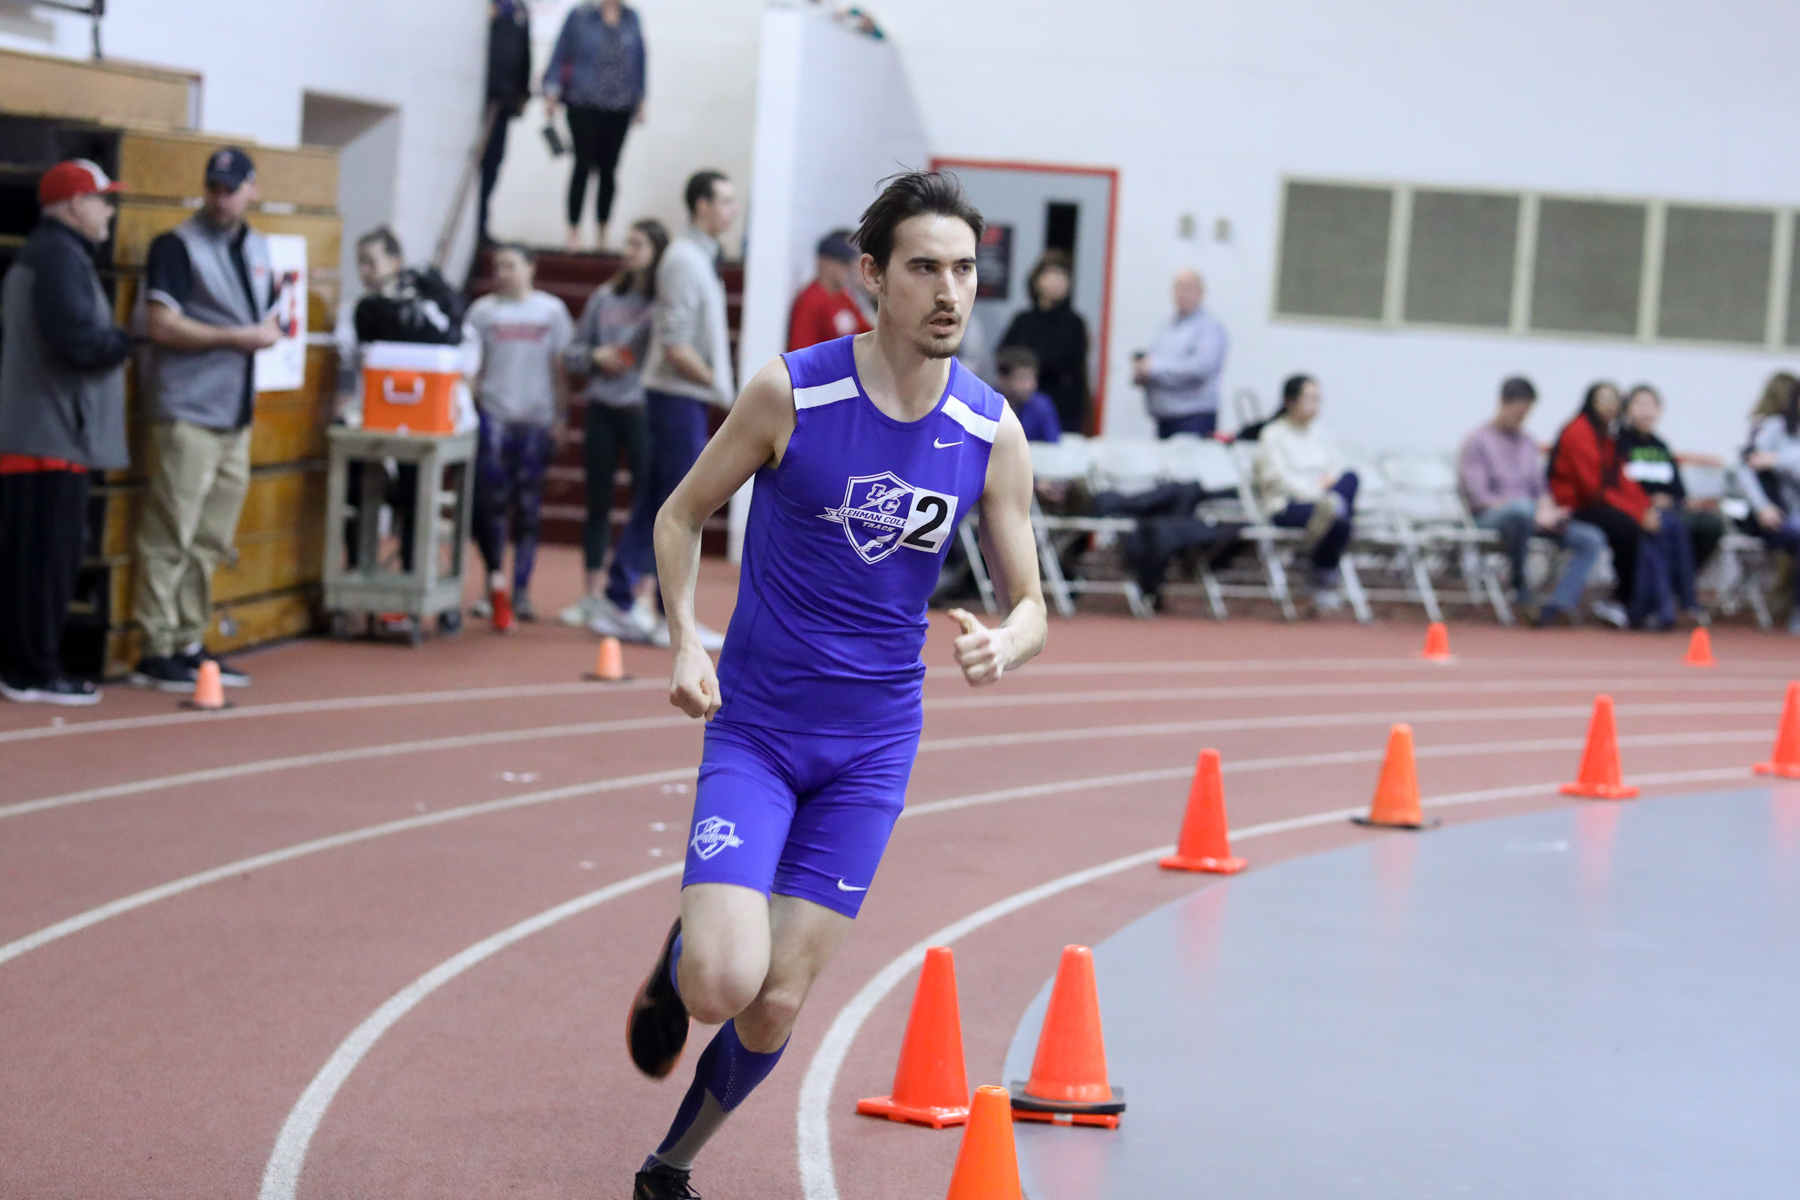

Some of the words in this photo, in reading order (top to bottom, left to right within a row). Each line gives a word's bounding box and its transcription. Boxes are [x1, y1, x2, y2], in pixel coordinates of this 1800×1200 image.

[841, 508, 883, 522] LEHMAN
[902, 495, 949, 549] 2
[862, 521, 896, 533] TRACK
